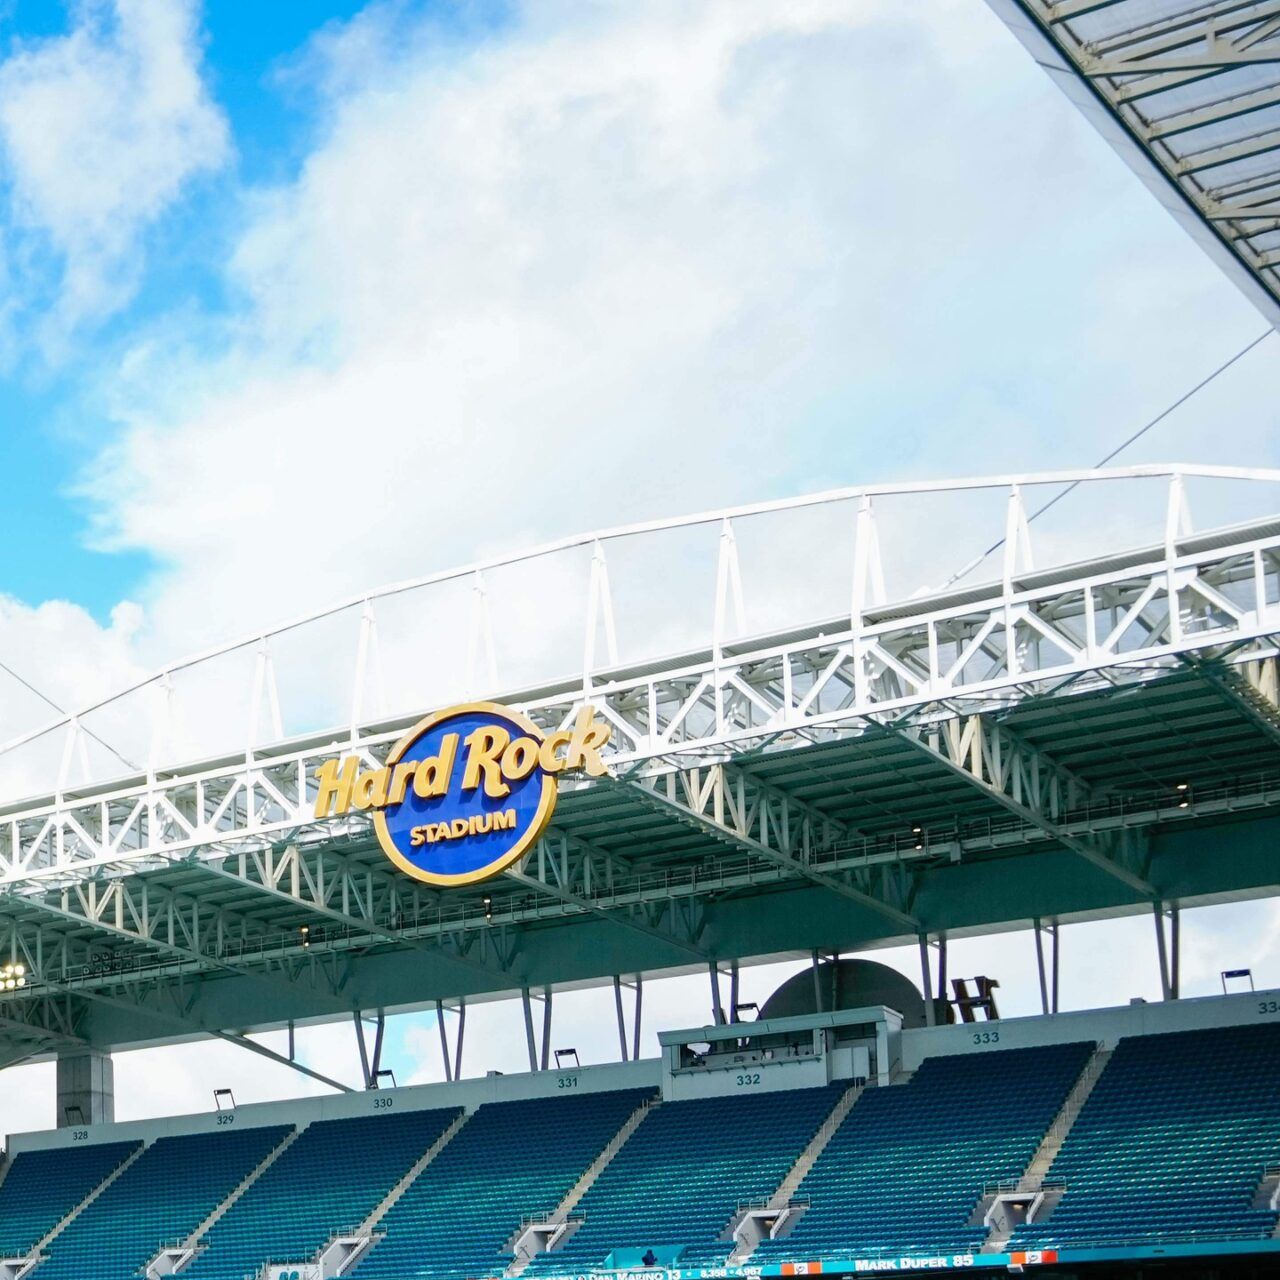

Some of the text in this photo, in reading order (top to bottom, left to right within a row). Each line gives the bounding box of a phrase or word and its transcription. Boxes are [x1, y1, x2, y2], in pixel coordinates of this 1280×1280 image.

[314, 705, 613, 818] Hard Rock
[409, 808, 517, 847] STADIUM
[1258, 1001, 1280, 1015] 33
[973, 1032, 1000, 1045] 333
[558, 1077, 578, 1089] 331
[736, 1074, 760, 1086] 332
[374, 1098, 393, 1109] 330
[216, 1115, 234, 1125] 329
[73, 1130, 88, 1141] 328
[855, 1255, 974, 1271] MARK DUPER 85
[667, 1270, 681, 1280] 13
